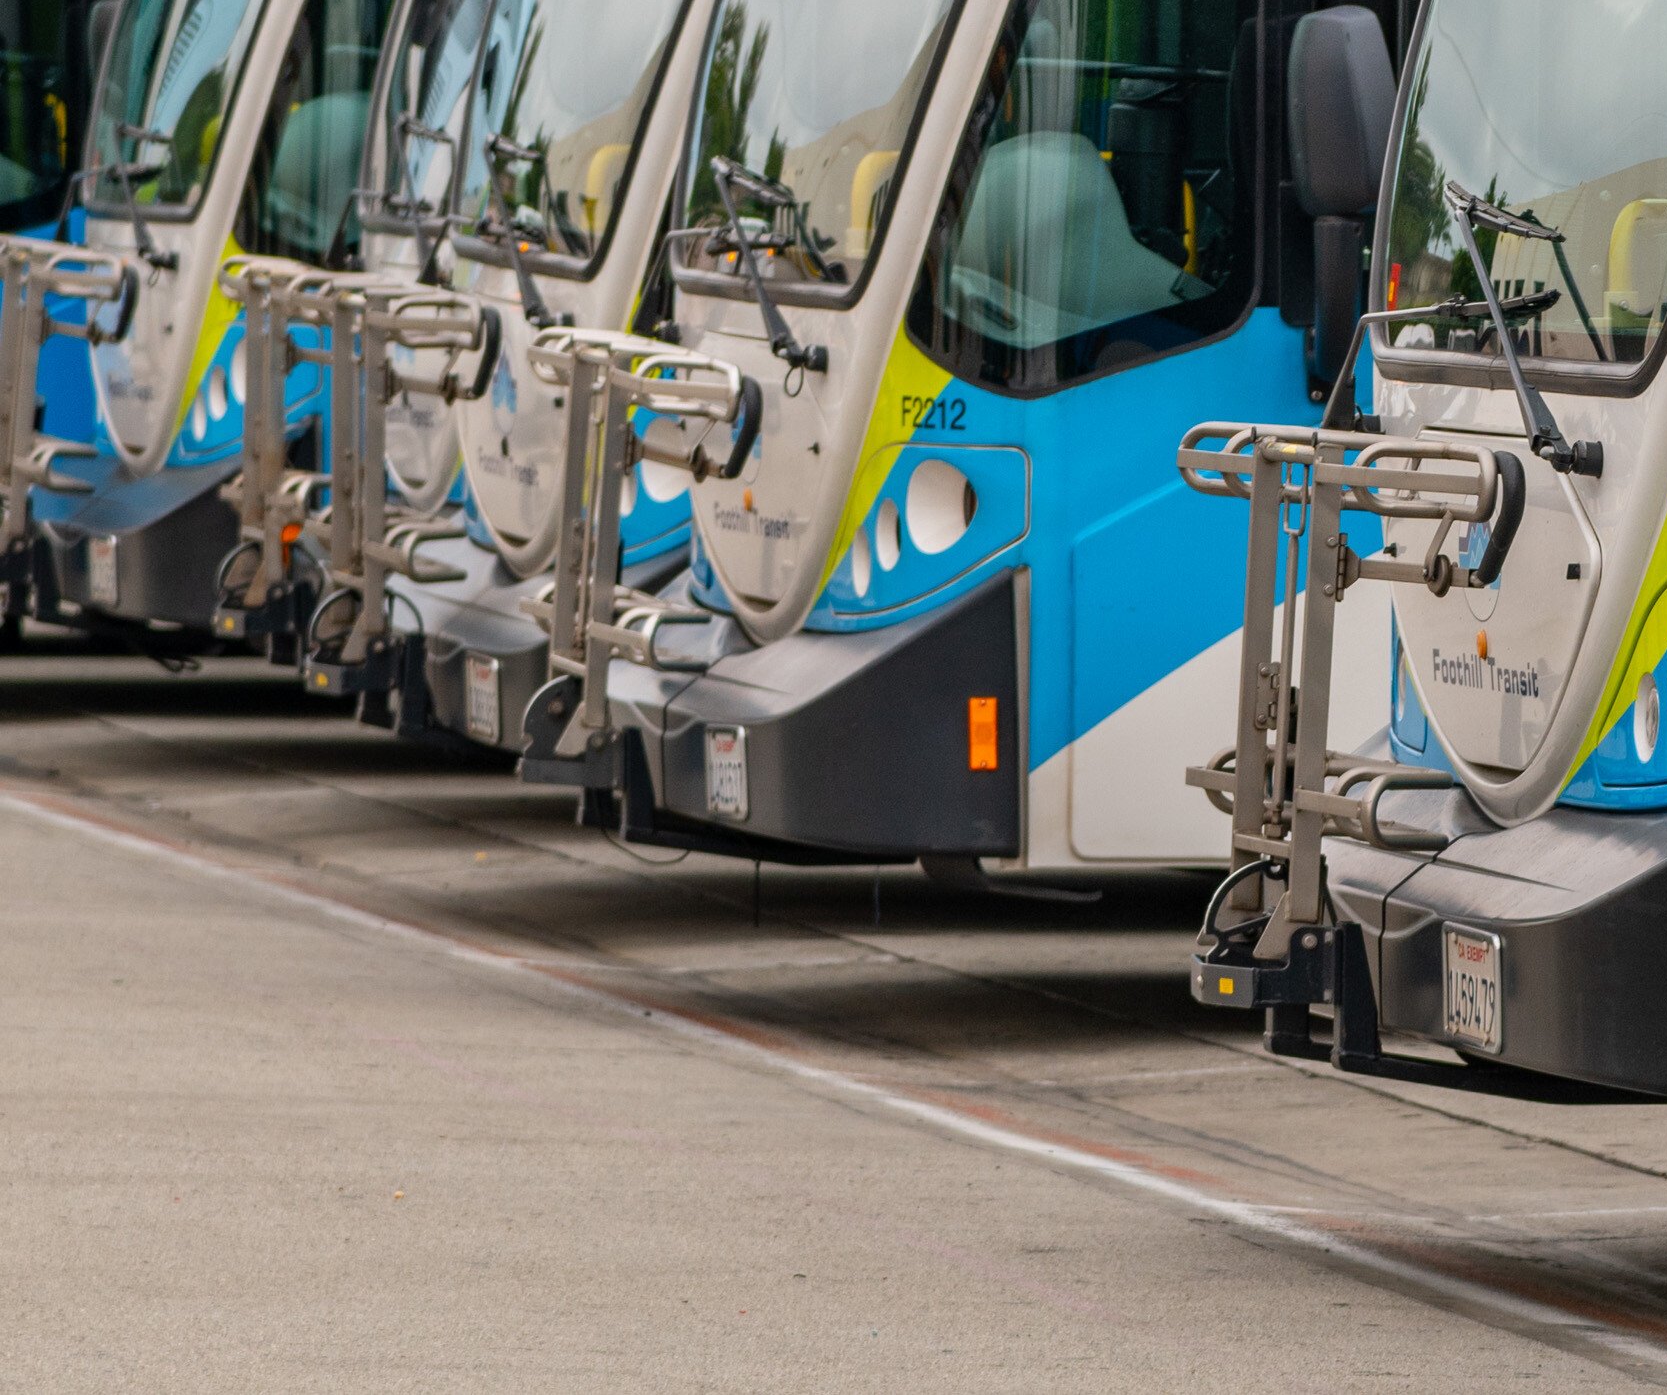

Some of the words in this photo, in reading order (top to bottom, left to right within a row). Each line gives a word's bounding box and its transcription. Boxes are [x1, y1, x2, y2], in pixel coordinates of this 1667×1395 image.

[901, 396, 966, 430] F2212
[1432, 648, 1483, 689] Foothill
[1487, 656, 1539, 698] Transit
[1448, 970, 1495, 1034] 1459479
